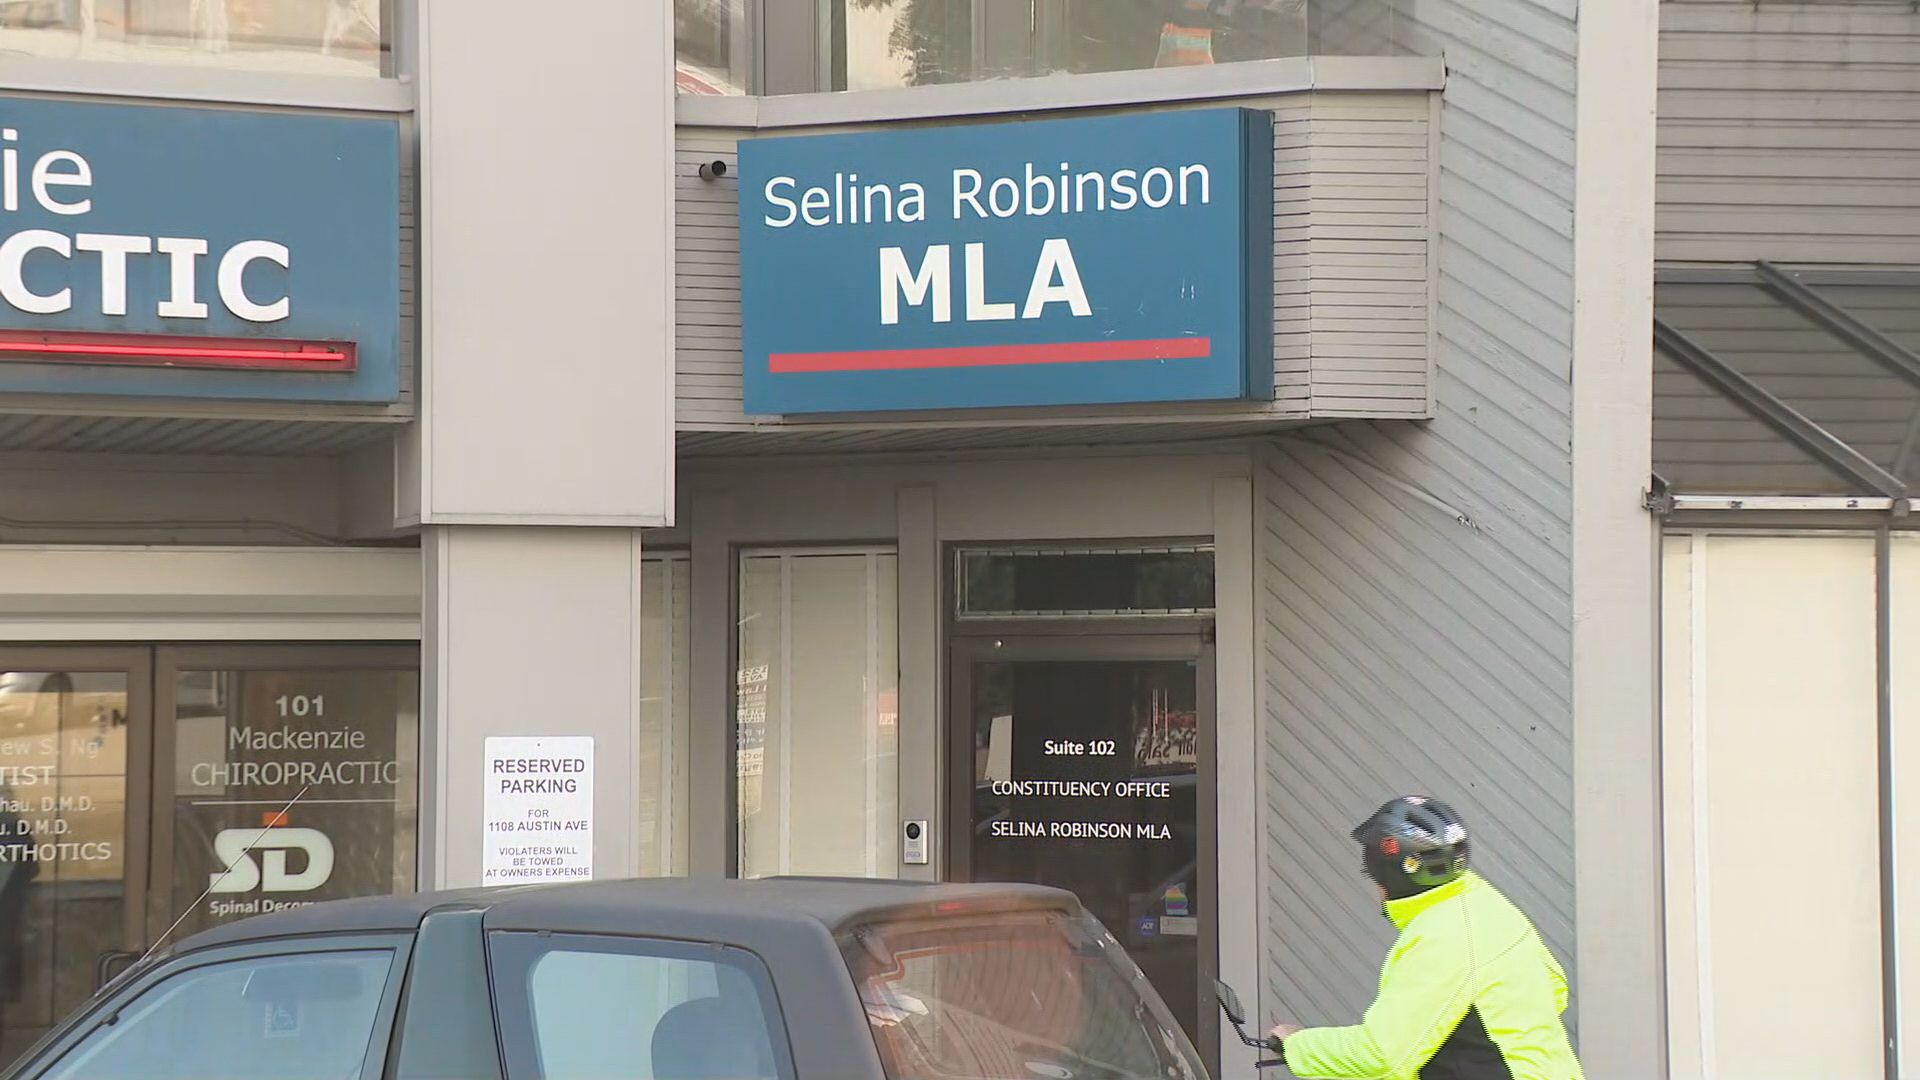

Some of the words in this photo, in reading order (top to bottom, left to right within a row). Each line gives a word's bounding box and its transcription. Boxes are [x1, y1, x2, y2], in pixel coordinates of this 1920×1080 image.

[763, 172, 926, 228] Selina
[952, 161, 1210, 220] Robinson
[0, 229, 290, 323] CTIC
[879, 238, 1093, 325] MLA
[275, 695, 325, 717] 101
[229, 725, 366, 750] Mackenzie
[71, 738, 98, 759] Ng
[1044, 740, 1084, 756] Suite
[1088, 740, 1116, 756] 102
[191, 760, 401, 786] CHIROPRACTIC
[493, 758, 585, 773] RESERVED
[501, 779, 577, 794] PARKING
[991, 780, 1111, 797] CONSTITUENCY
[1115, 782, 1170, 798] OFFICE
[41, 796, 96, 812] D.M.D.
[528, 809, 549, 818] FOR
[17, 819, 72, 835] D.M.D.
[489, 822, 514, 832] 1108
[517, 821, 561, 831] AUSTIN
[565, 820, 588, 831] AVE
[991, 821, 1046, 837] SELINA
[1050, 823, 1132, 839] ROBINSON
[1136, 825, 1171, 840] MLA
[499, 847, 552, 855] VIOLATERS
[555, 847, 577, 855] WILL
[209, 828, 335, 893] SD
[513, 858, 526, 866] BE
[530, 857, 563, 866] TOWED
[486, 869, 497, 877] AT
[500, 868, 543, 877] OWNERS
[546, 867, 590, 876] EXPENSE
[209, 899, 259, 917] Spinal
[262, 899, 315, 912] Deco
